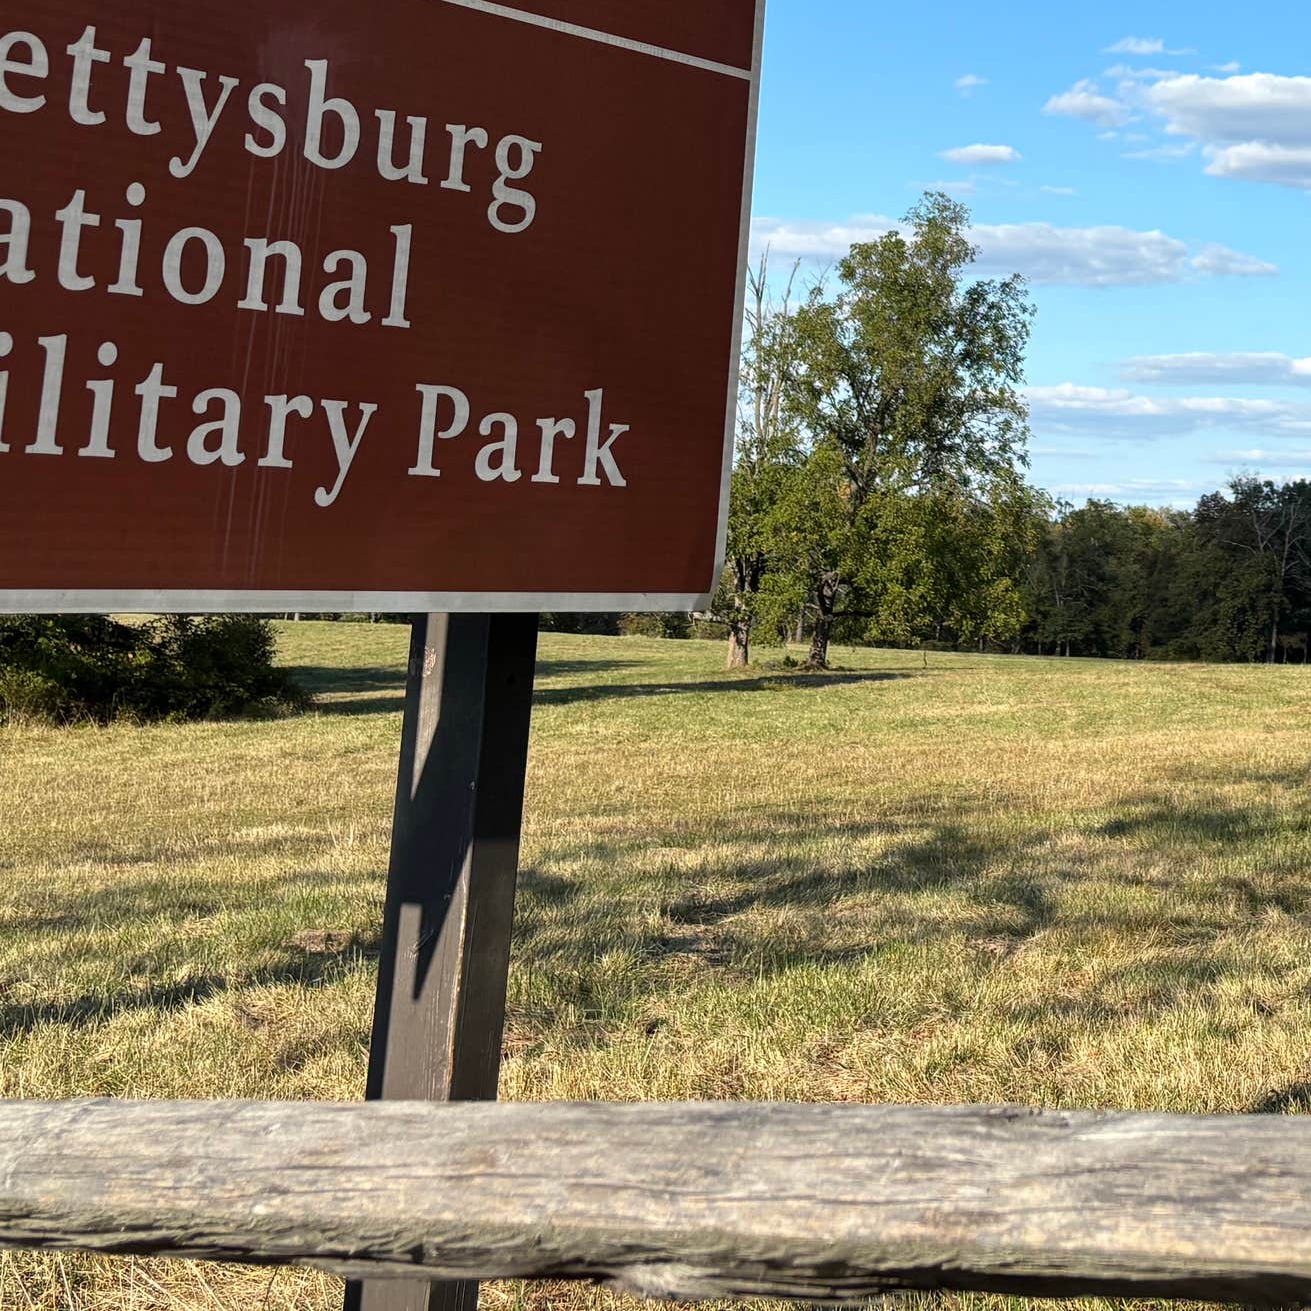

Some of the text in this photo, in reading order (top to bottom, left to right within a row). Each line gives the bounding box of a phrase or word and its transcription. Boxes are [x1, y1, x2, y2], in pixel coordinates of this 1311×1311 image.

[0, 25, 543, 233] ettysburg
[0, 181, 413, 329] ational
[407, 383, 630, 488] Park
